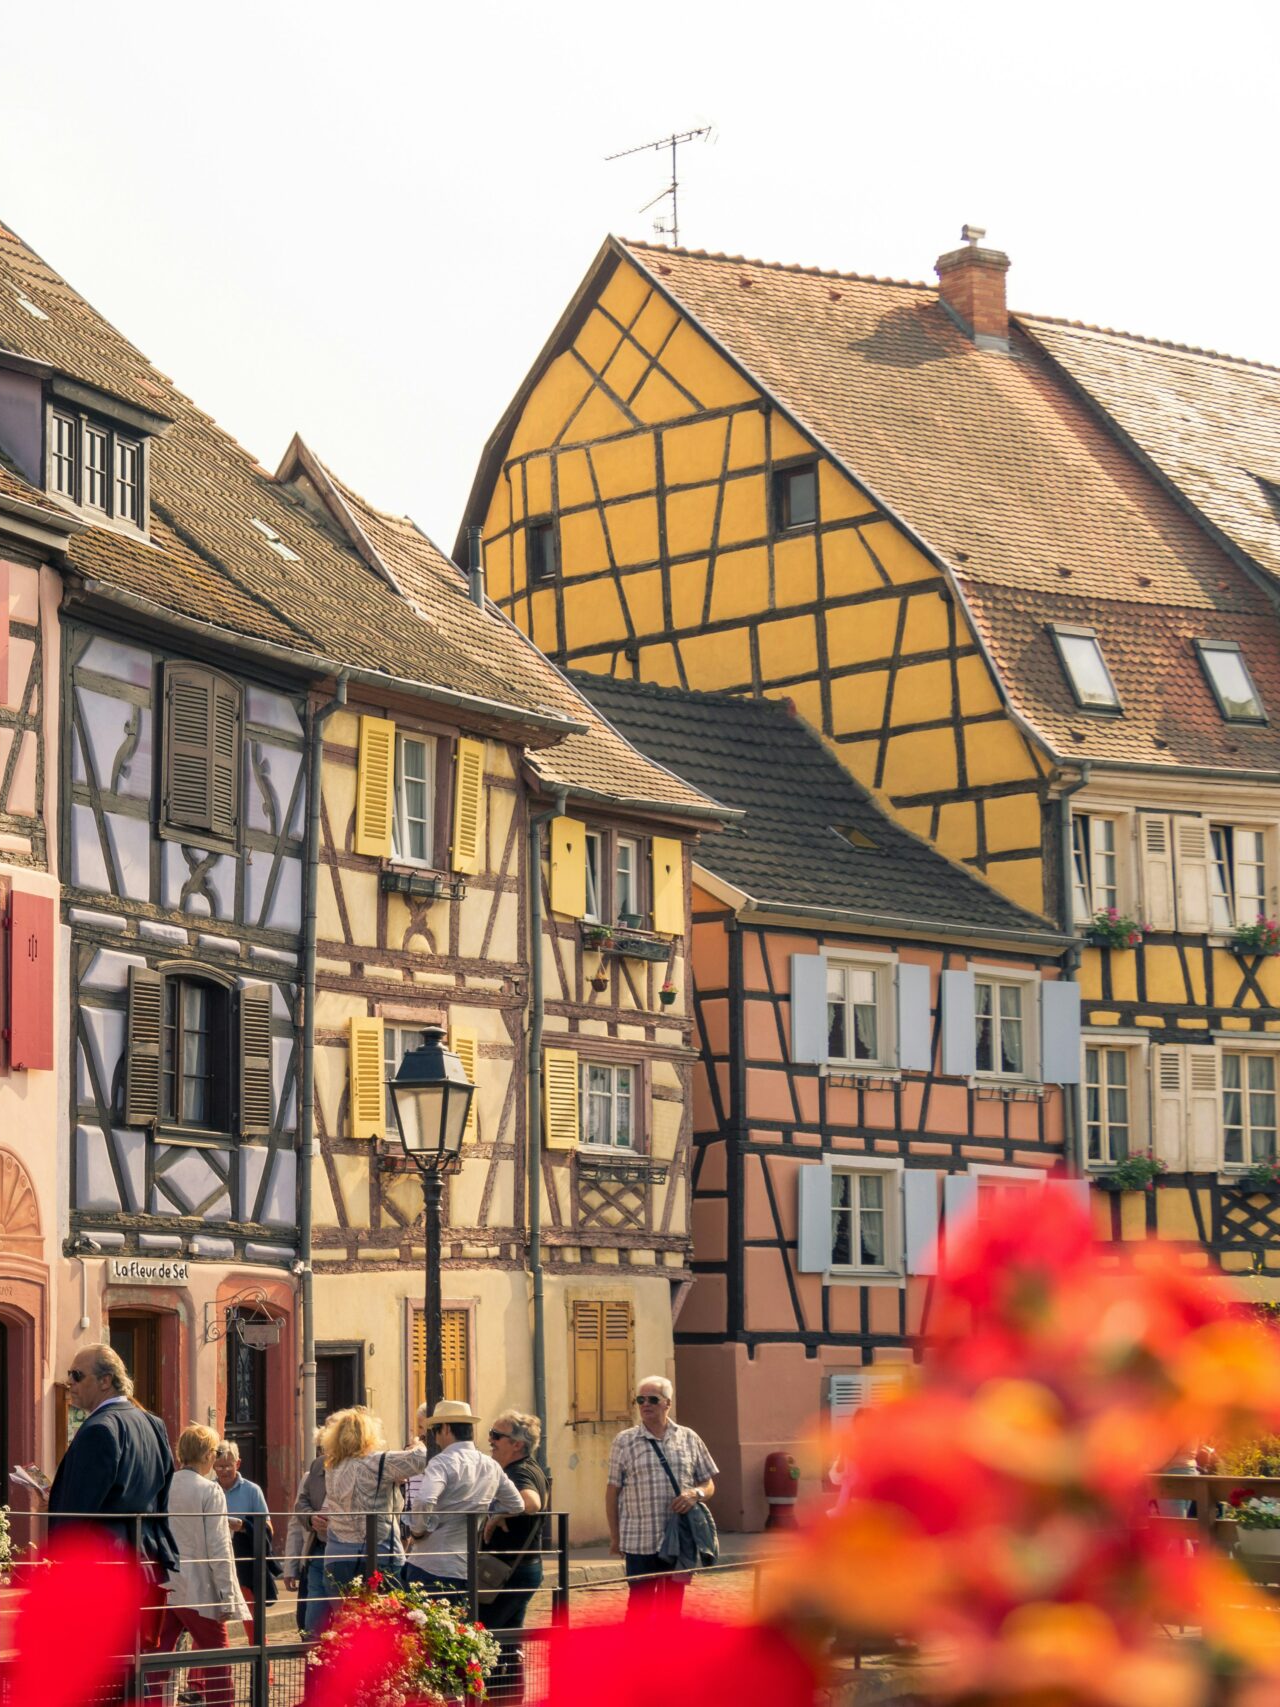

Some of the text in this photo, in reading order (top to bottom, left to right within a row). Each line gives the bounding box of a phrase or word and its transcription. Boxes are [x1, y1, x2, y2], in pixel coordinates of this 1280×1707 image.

[116, 1262, 128, 1276] La
[159, 1264, 170, 1278] de
[173, 1264, 188, 1278] Sel
